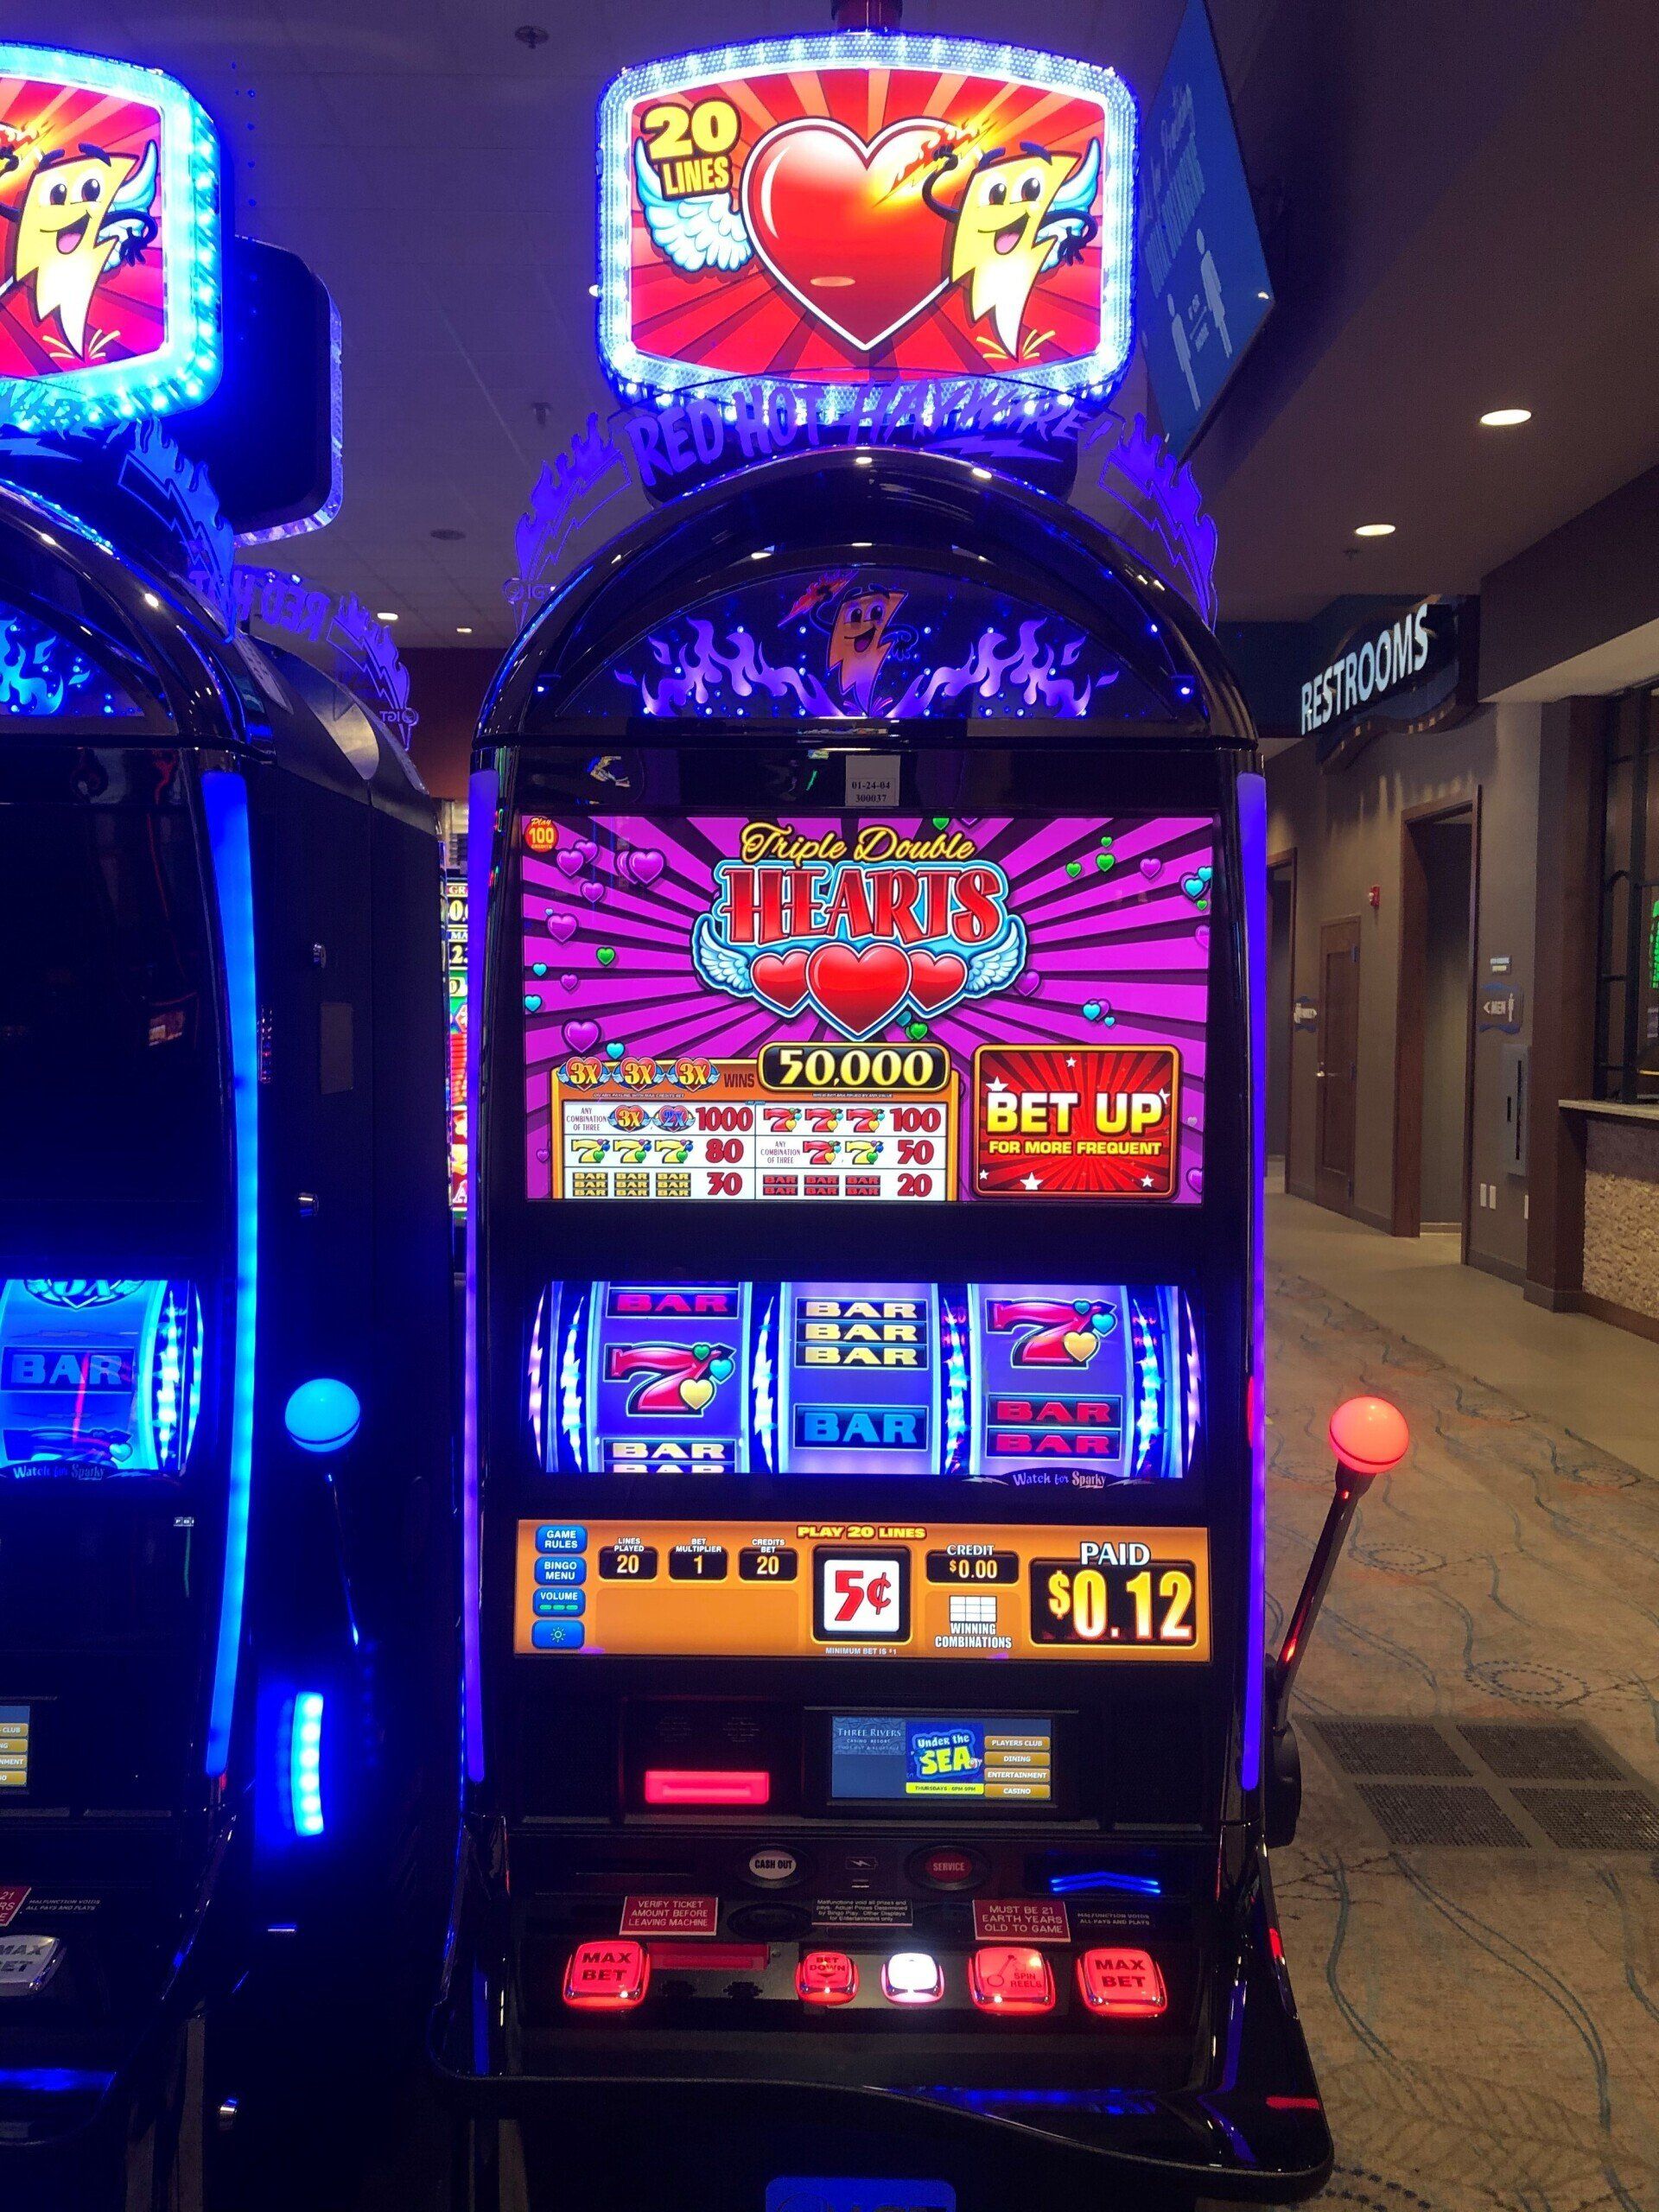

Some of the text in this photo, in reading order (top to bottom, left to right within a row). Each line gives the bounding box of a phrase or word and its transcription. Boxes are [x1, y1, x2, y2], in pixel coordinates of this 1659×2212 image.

[643, 99, 739, 160] 20
[662, 156, 730, 195] LINES
[625, 399, 724, 486] RED
[734, 385, 824, 458] HOT
[1300, 603, 1428, 735] RESTROOMS
[851, 781, 892, 790] 01-24-04
[528, 827, 554, 843] 100
[741, 821, 976, 866] Triple Double
[721, 867, 1002, 944] HEARTS
[569, 1048, 934, 1088] 3X 3X 3X WINS 50,000
[617, 1109, 641, 1128] 3X
[695, 1106, 754, 1133] 1000
[889, 1107, 942, 1134] 100
[986, 1091, 1163, 1135] BET UP
[704, 1138, 745, 1164] 80
[897, 1139, 935, 1166] 50
[988, 1141, 1162, 1156] FOR MORE FREQUENT
[706, 1172, 743, 1197] 30
[764, 1173, 933, 1198] BAR BAR BAR 20
[764, 1187, 880, 1197] BAR BAR BAR
[616, 1294, 729, 1313] BAR
[804, 1300, 918, 1320] BAR
[804, 1323, 918, 1342] BAR
[987, 1298, 1116, 1370] 7
[804, 1346, 918, 1366] BAR
[10, 1354, 123, 1385] BAR
[603, 1341, 736, 1417] 7
[996, 1401, 1112, 1423] BAR
[804, 1412, 918, 1444] BAR
[613, 1442, 727, 1459] BAR
[995, 1433, 1110, 1455] BAR
[1013, 1471, 1107, 1489] Watch for Sparky
[546, 1530, 576, 1540] GAME
[797, 1525, 926, 1540] PLAY 20 LINES
[544, 1540, 578, 1548] RULES
[676, 1545, 722, 1554] MULTIPLIER
[752, 1538, 785, 1547] CREDITS
[946, 1544, 995, 1556] CREDIT
[1080, 1541, 1152, 1566] PAID
[543, 1561, 577, 1571] BINGO
[617, 1554, 639, 1574] 20
[693, 1555, 703, 1574] 1
[756, 1555, 779, 1575] 20
[950, 1559, 998, 1580] $0.00
[545, 1571, 575, 1580] MENU
[540, 1592, 578, 1600] VOLUME
[834, 1569, 893, 1622] 5¢
[1048, 1568, 1193, 1640] $0.12
[950, 1623, 996, 1635] WINNING
[862, 1647, 877, 1656] BET
[879, 1647, 887, 1656] IS
[935, 1636, 1013, 1649] COMBINATIONS
[838, 1728, 901, 1737] THREE RIVERS
[918, 1733, 970, 1748] Under the
[920, 1745, 973, 1776] SEA
[754, 1859, 793, 1870] CASH OUT
[932, 1860, 965, 1872] SERVICE
[631, 1909, 709, 1917] AMOUNT BEFORE
[982, 1914, 1063, 1924] EARTH YEARS
[989, 1905, 1020, 1914] MUST
[1041, 1906, 1053, 1915] 21
[628, 1918, 709, 1927] LEAVING MACHINE
[984, 1923, 1064, 1933] OLD TO GAME
[581, 1952, 633, 1964] MAX
[1095, 1959, 1145, 1971] MAX
[581, 1968, 628, 1981] BET
[1013, 1972, 1036, 1980] SPIN
[1101, 1974, 1147, 1987] BET
[1009, 1980, 1043, 1988] REELS
